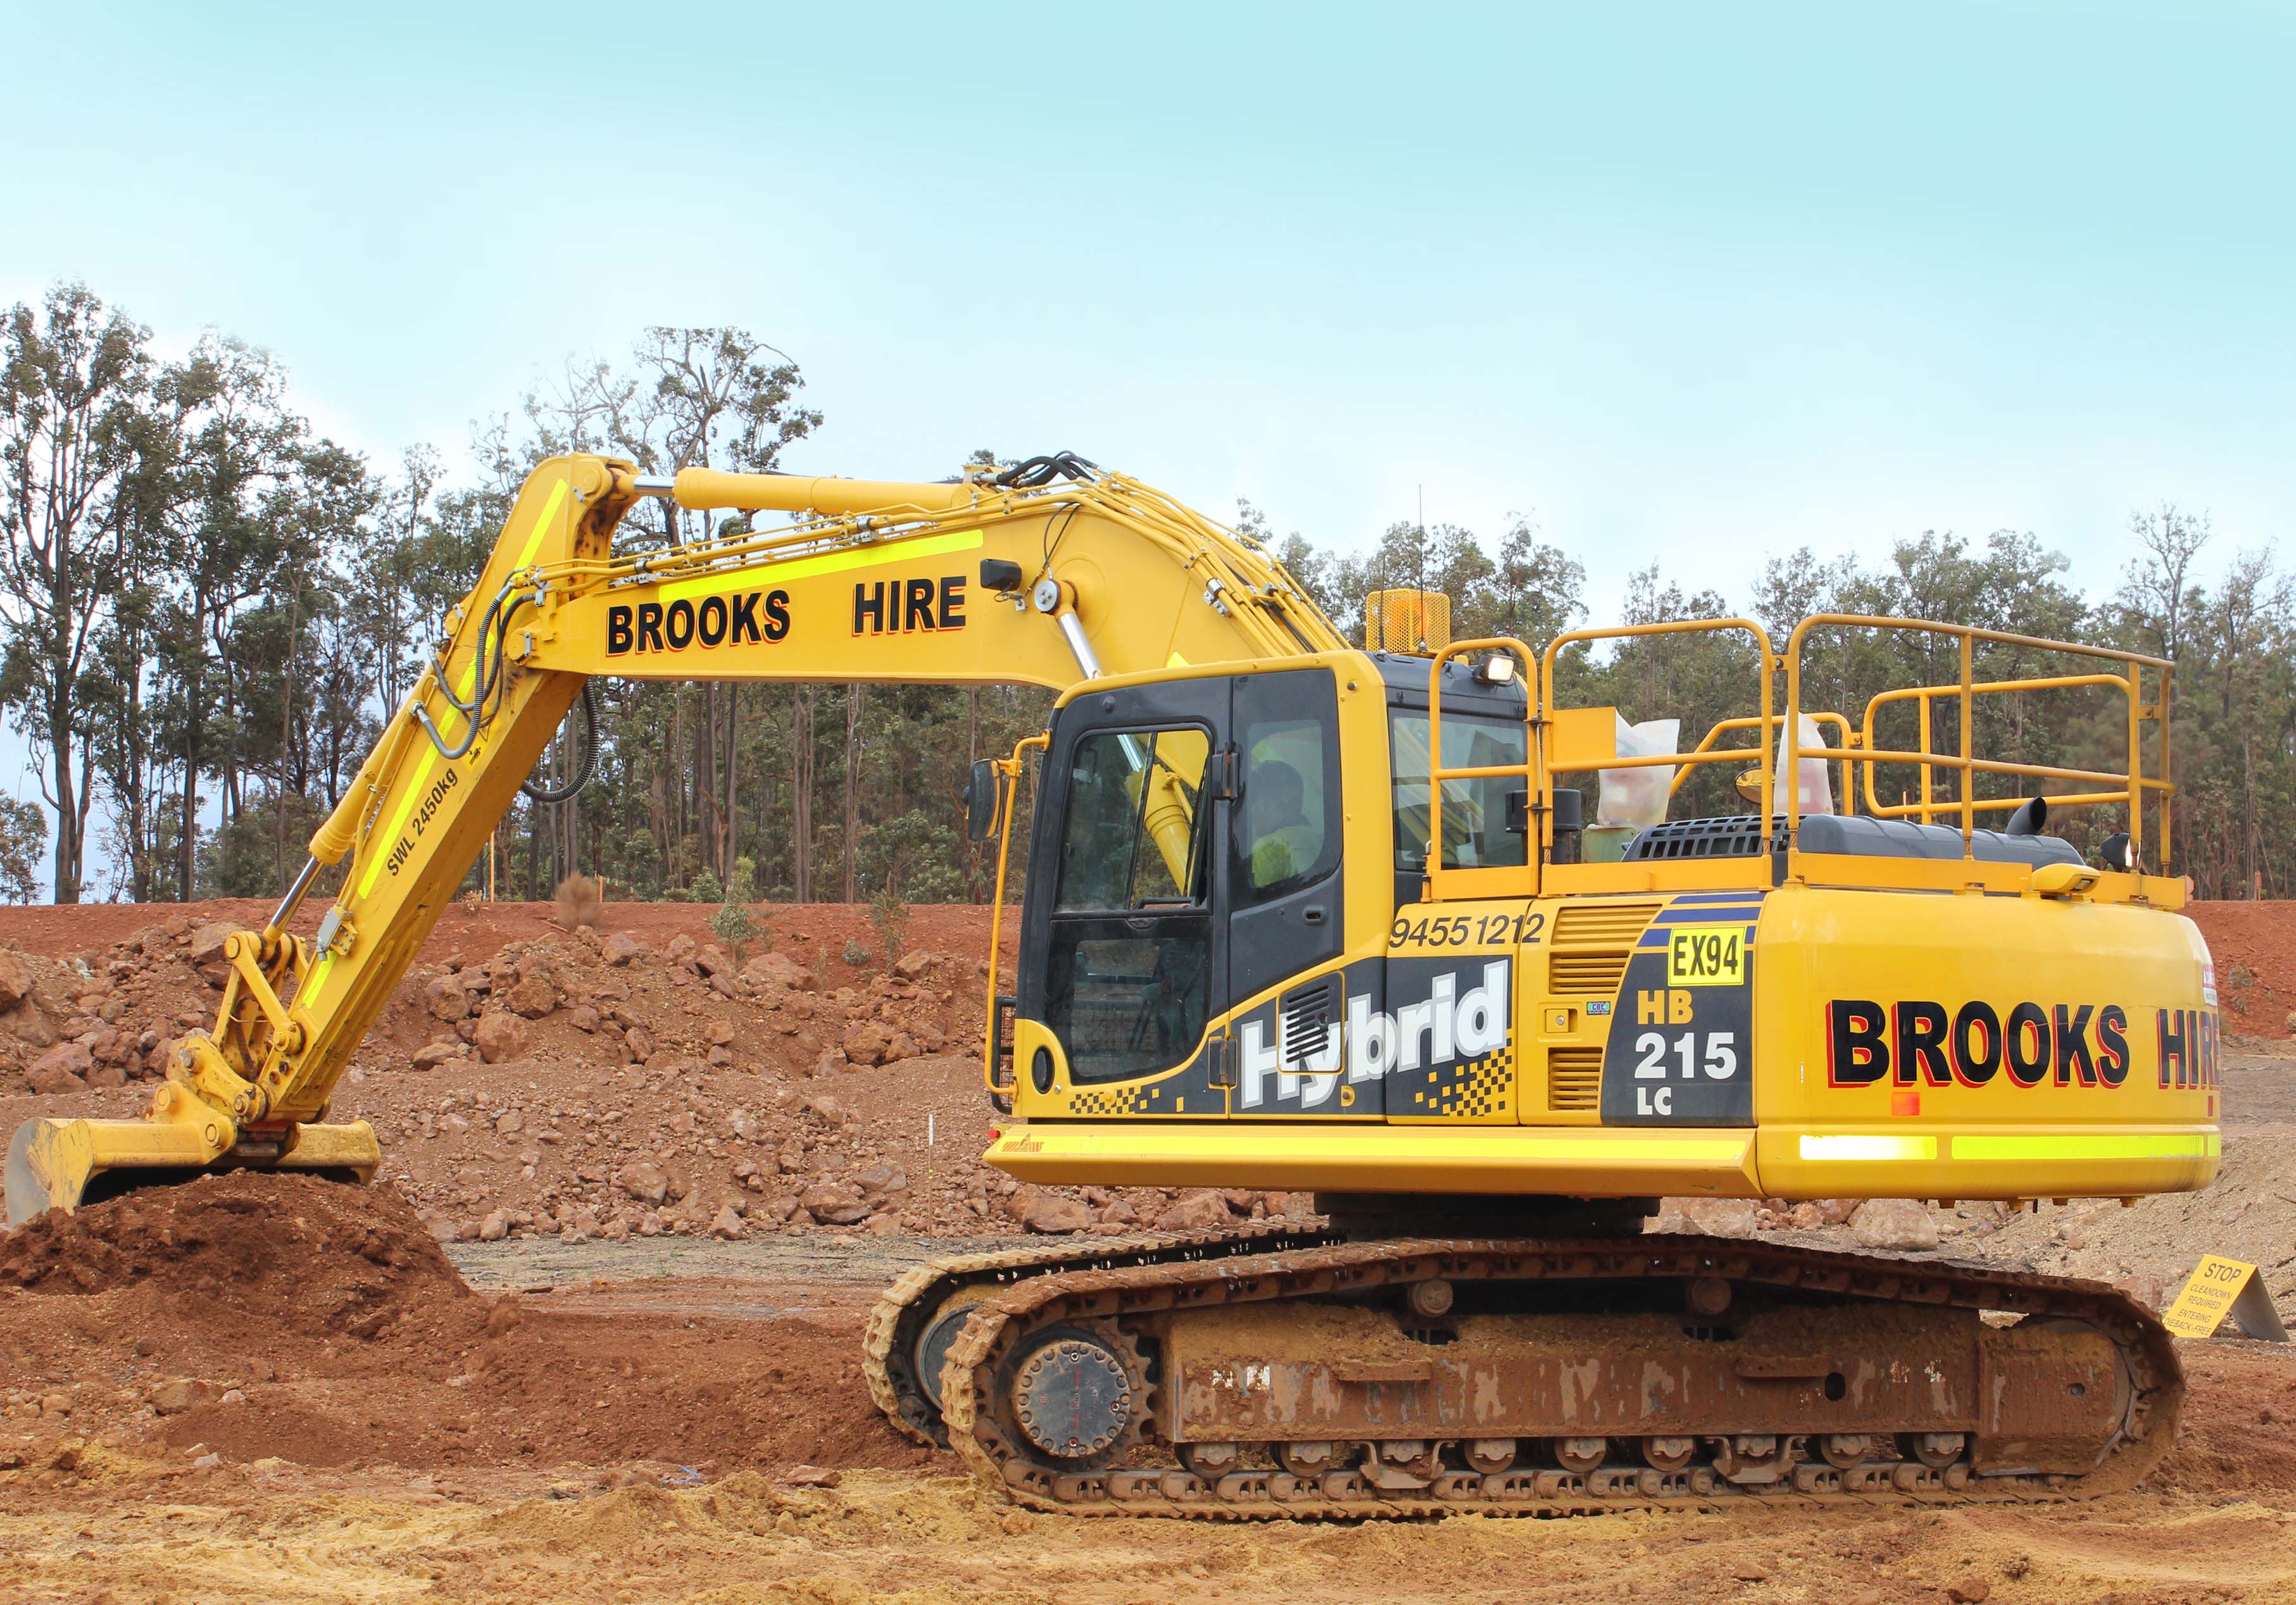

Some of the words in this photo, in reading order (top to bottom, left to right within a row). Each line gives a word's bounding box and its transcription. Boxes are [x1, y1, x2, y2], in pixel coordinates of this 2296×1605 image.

[606, 589, 791, 657] BROOKS
[852, 575, 967, 636] HIRE
[387, 836, 415, 877] SWL
[412, 768, 458, 837] 2450kg
[1673, 935, 1739, 977] EX94
[1637, 989, 1694, 1025] HB
[1241, 959, 1509, 1109] Hybrid
[1826, 1000, 2130, 1089] BROOKS
[1634, 1032, 1737, 1080] 215
[1637, 1087, 1672, 1115] LC
[2190, 1283, 2233, 1300] CLEANDOWN
[2204, 1263, 2242, 1283] STOP
[2178, 1308, 2212, 1323] ENTERING
[2187, 1296, 2221, 1309] REQUIRED
